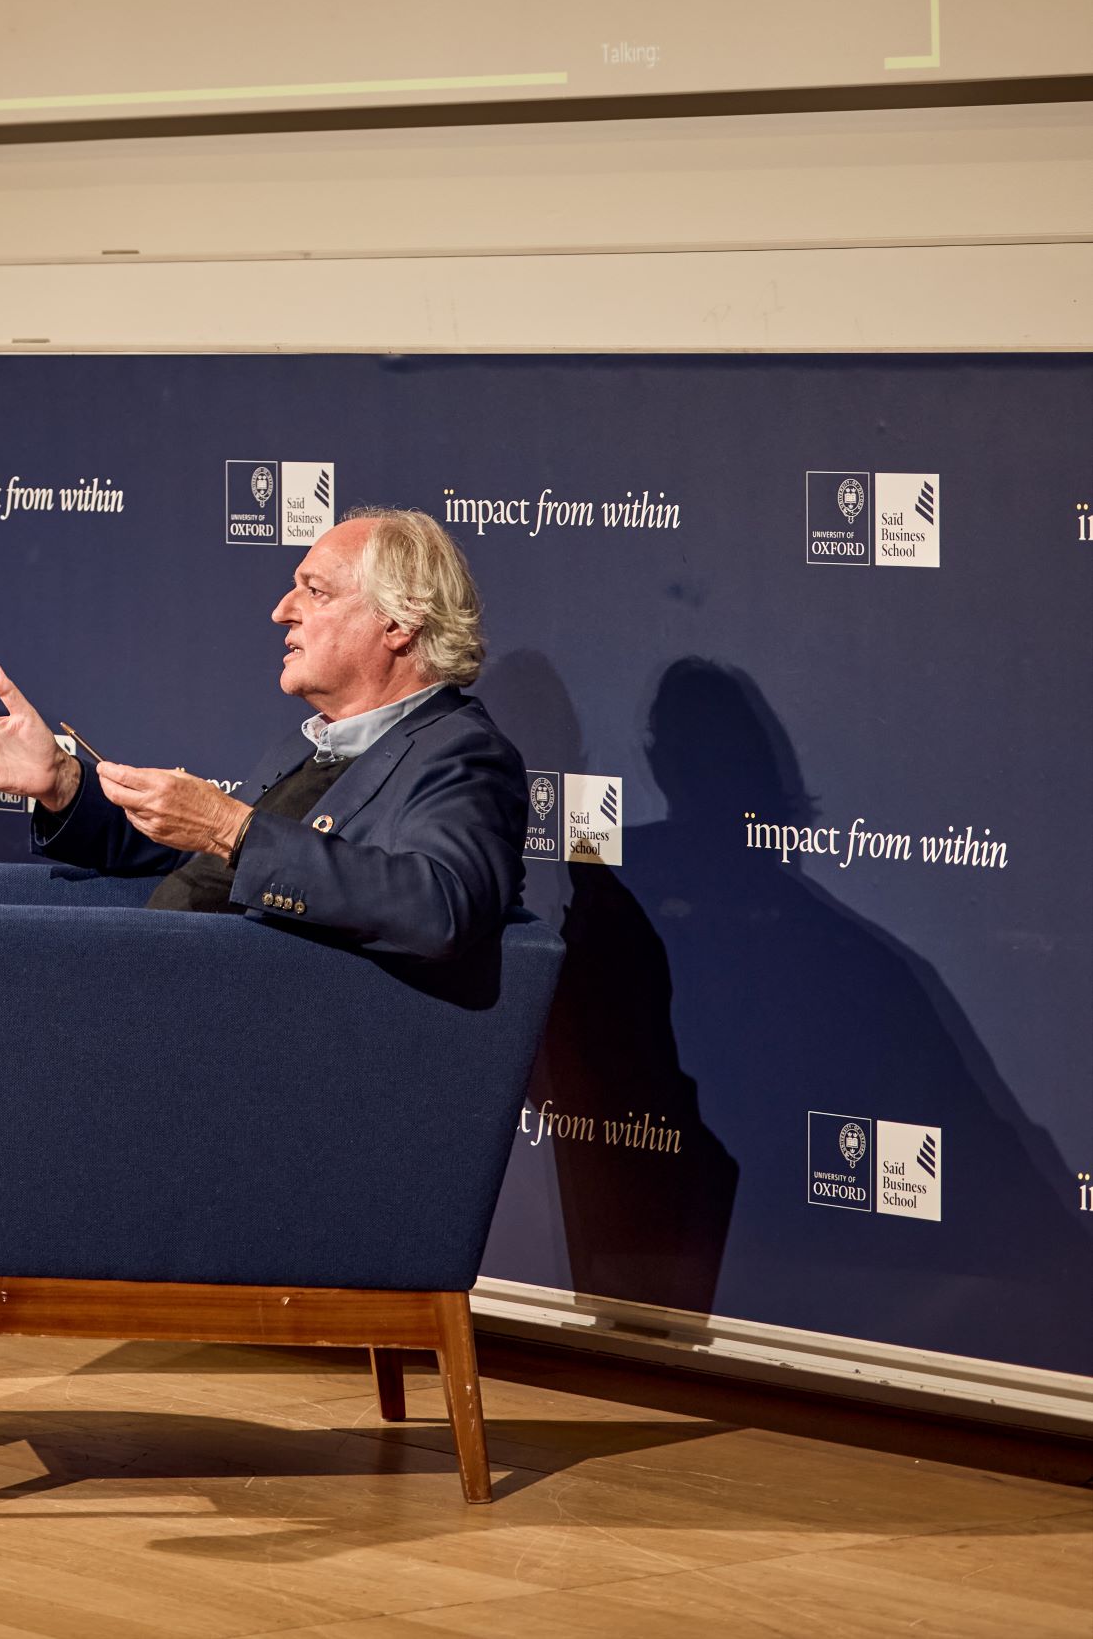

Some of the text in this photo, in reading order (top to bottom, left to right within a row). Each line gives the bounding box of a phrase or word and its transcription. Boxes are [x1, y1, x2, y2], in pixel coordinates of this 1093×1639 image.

[0, 476, 54, 520] from
[59, 477, 124, 513] within
[287, 511, 323, 524] Business
[529, 488, 595, 537] from
[601, 490, 681, 529] within
[230, 523, 274, 537] OXFORD
[287, 525, 315, 538] School
[812, 530, 855, 539] UNIVERSITY OF
[881, 528, 926, 542] Business
[811, 541, 865, 556] OXFORD
[881, 543, 916, 558] School
[569, 826, 610, 842] Business
[524, 836, 555, 852] FORD
[569, 840, 601, 855] School
[839, 818, 912, 869] from
[919, 825, 1008, 870] within
[530, 1100, 595, 1146] from
[603, 1111, 682, 1154] within
[813, 1170, 856, 1183] UNIVERSITY OF
[813, 1181, 866, 1202] OXFORD
[882, 1176, 927, 1194] Business
[882, 1191, 917, 1209] School
